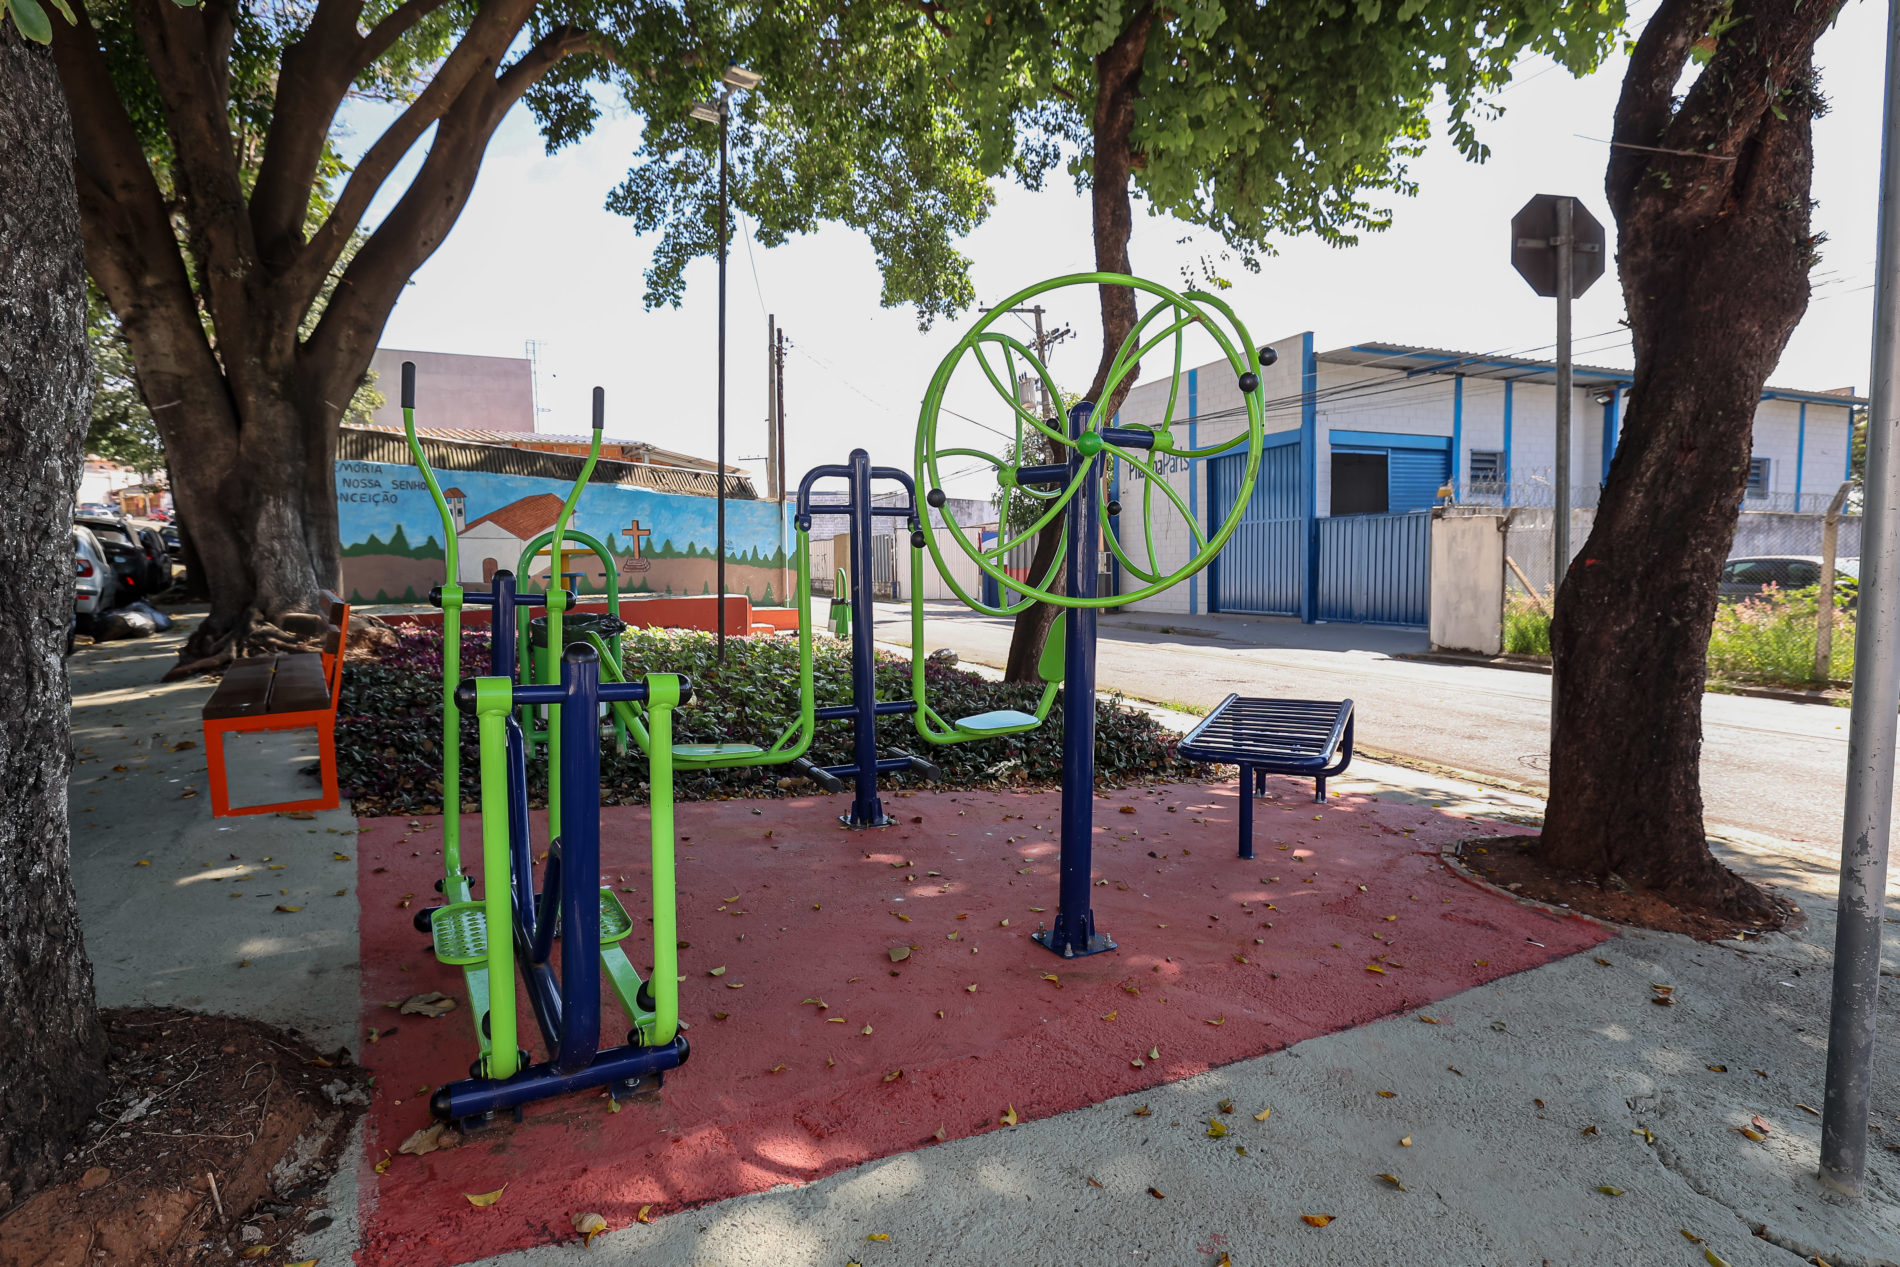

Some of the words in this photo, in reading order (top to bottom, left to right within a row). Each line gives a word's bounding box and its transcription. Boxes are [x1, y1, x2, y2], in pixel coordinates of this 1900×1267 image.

[342, 478, 382, 489] NOSSA
[391, 479, 428, 491] SENHO
[337, 490, 398, 506] NCEIÇÃO
